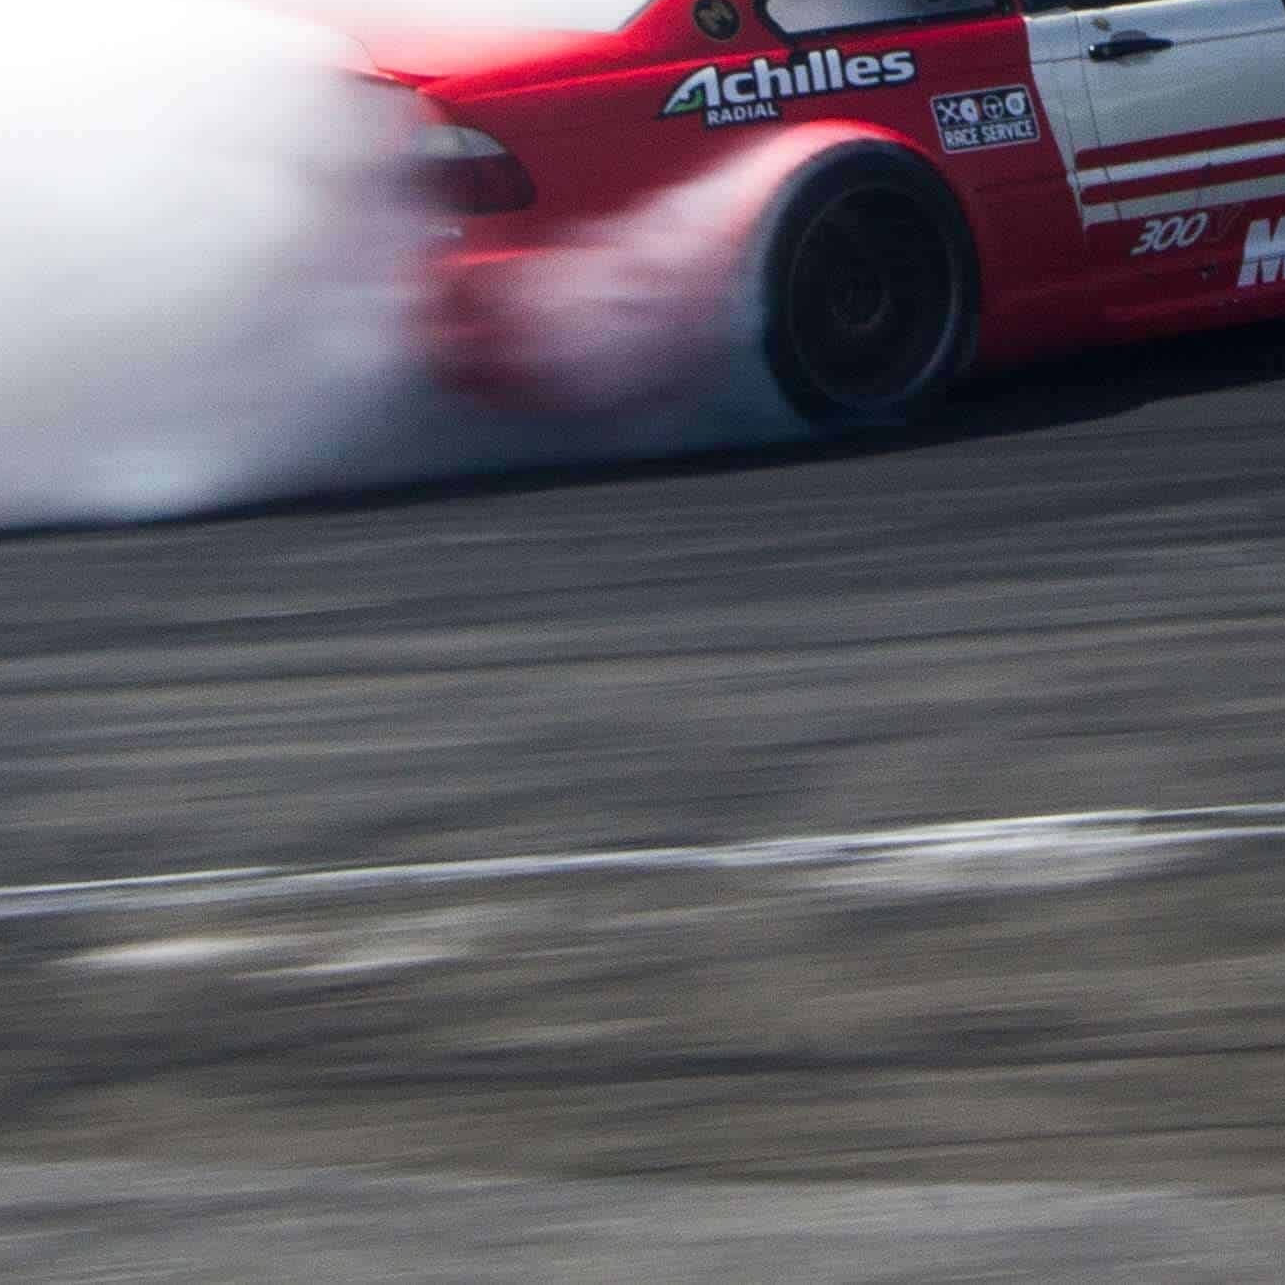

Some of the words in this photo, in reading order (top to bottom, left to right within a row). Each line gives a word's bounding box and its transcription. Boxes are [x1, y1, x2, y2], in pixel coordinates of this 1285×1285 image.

[662, 48, 916, 115] Achilles
[706, 101, 779, 126] RADIAL
[944, 126, 980, 149] RACE
[981, 119, 1035, 145] SERVICE
